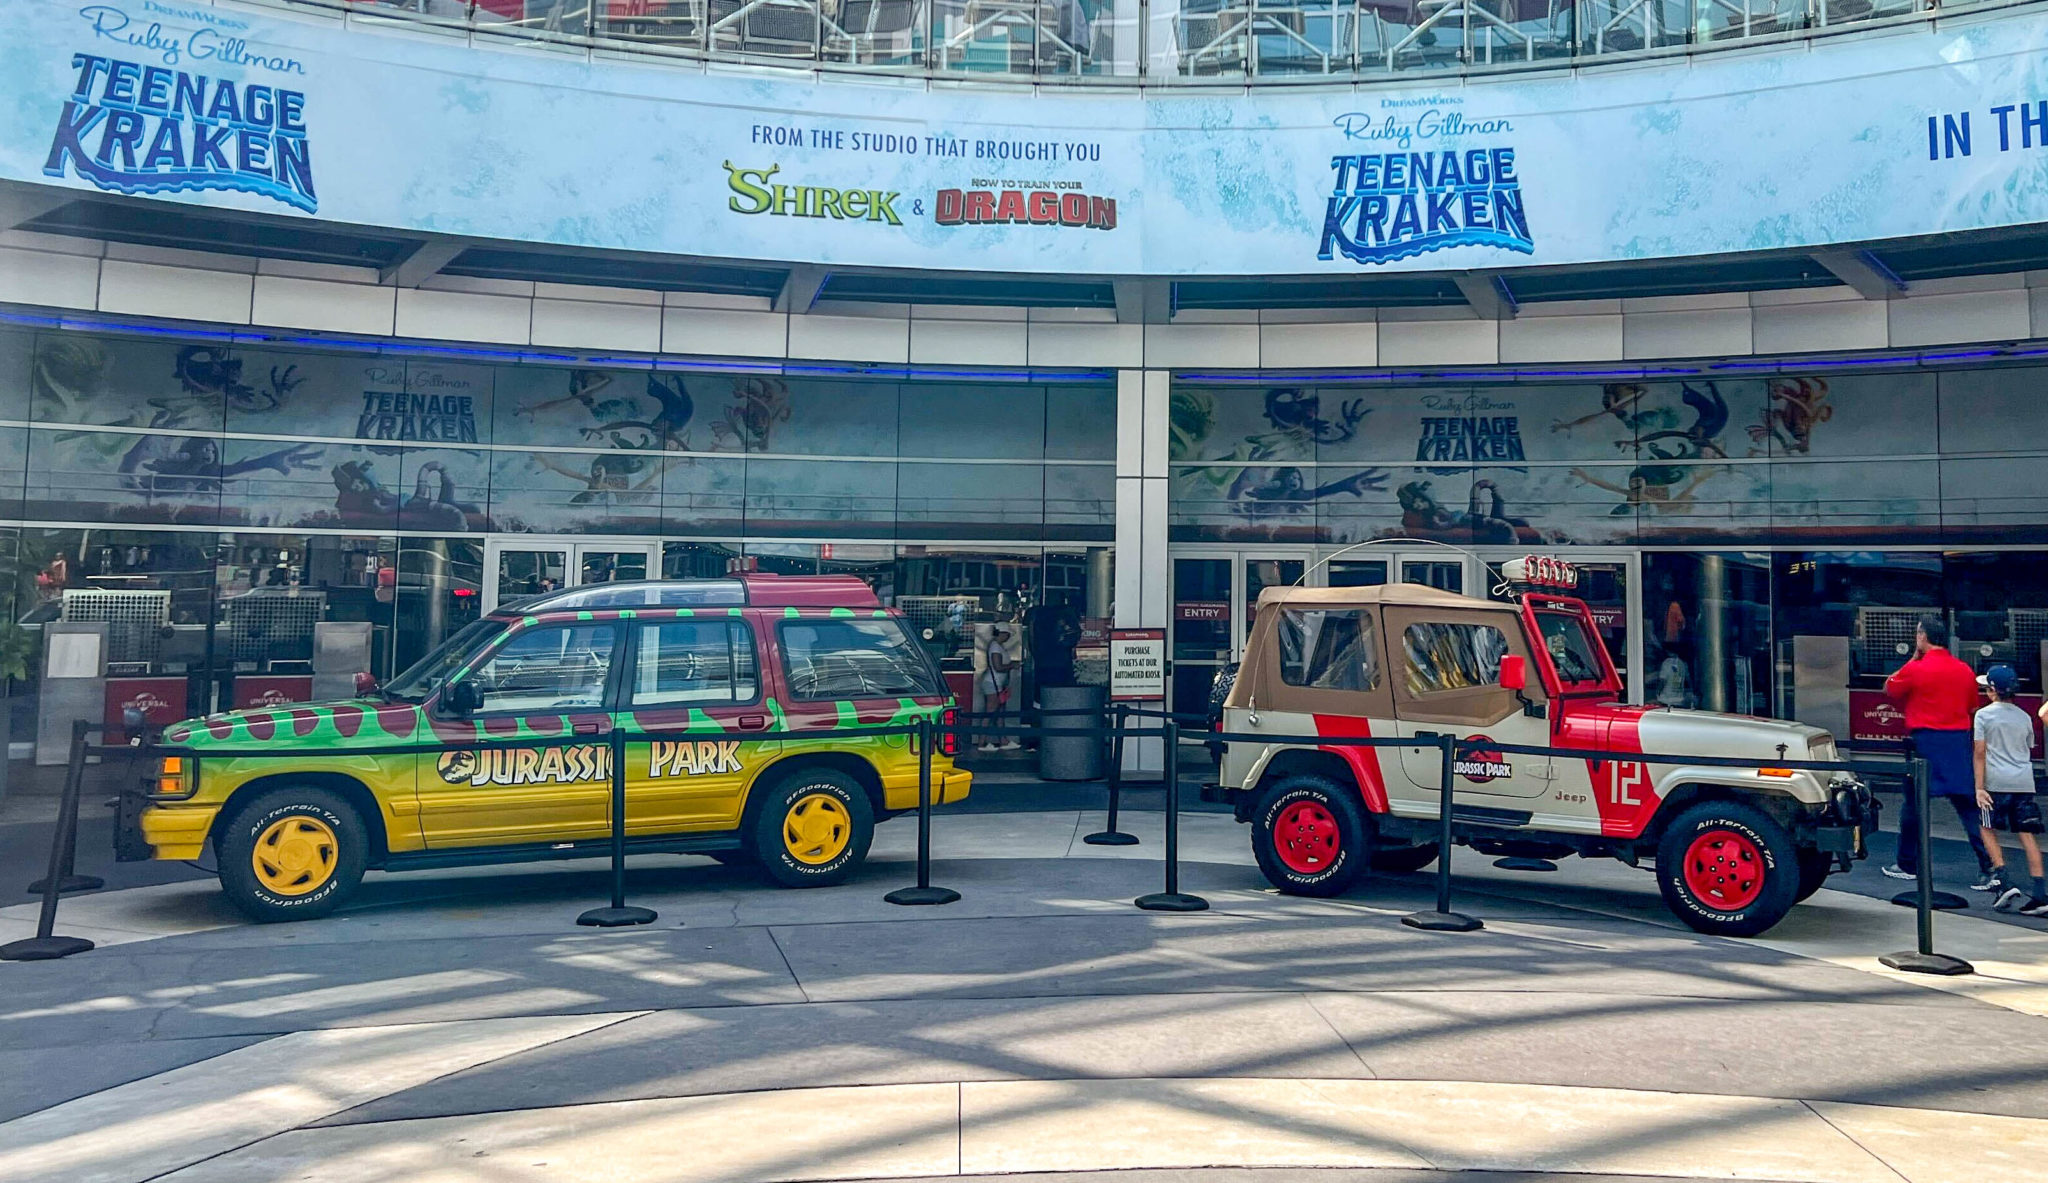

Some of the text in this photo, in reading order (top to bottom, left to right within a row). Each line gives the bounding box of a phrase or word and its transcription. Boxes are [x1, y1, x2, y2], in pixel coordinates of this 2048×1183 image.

[79, 5, 305, 75] Ruby Gillman
[71, 53, 306, 138] TEENAGE
[752, 125, 1101, 162] FROM THE STUDIO THAT BROUGHT YOU
[1333, 109, 1513, 148] Ruby Gillman
[1928, 111, 1971, 160] IN
[43, 101, 317, 210] KRAKEN
[971, 178, 1083, 190] HOW TO TRAIN YOUR
[1331, 147, 1518, 196] TEENAGE
[912, 198, 925, 216] &
[935, 188, 1118, 231] DRAGON
[1317, 189, 1534, 262] KRAKEN
[363, 391, 474, 416] TEENAGE
[355, 414, 479, 445] KRAKEN
[1421, 416, 1520, 438] TEENAGE
[1416, 438, 1527, 462] KRAKEN
[1184, 608, 1220, 618] ENTRY
[1117, 658, 1158, 667] TICKETS AT OUR
[1124, 646, 1151, 655] PURCHASE
[1114, 670, 1161, 679] AUTOMATED KIOSK
[121, 700, 170, 709] UNIVERSAL
[471, 740, 743, 787] JURASSI PARK
[1453, 761, 1511, 777] URASSIC PARK
[786, 783, 851, 805] BFGoodrich
[1555, 790, 1587, 803] Jeep
[1608, 759, 1641, 806] 12
[251, 804, 341, 837] All-Terrain T/A
[1264, 789, 1310, 830] All-Terrain
[1696, 818, 1764, 847] All-Terrain
[796, 847, 853, 874] All-Terrain
[1286, 849, 1347, 884] BFGoodrich
[254, 879, 338, 907] BFGoodrich
[1673, 877, 1745, 922] BFGoodrich
